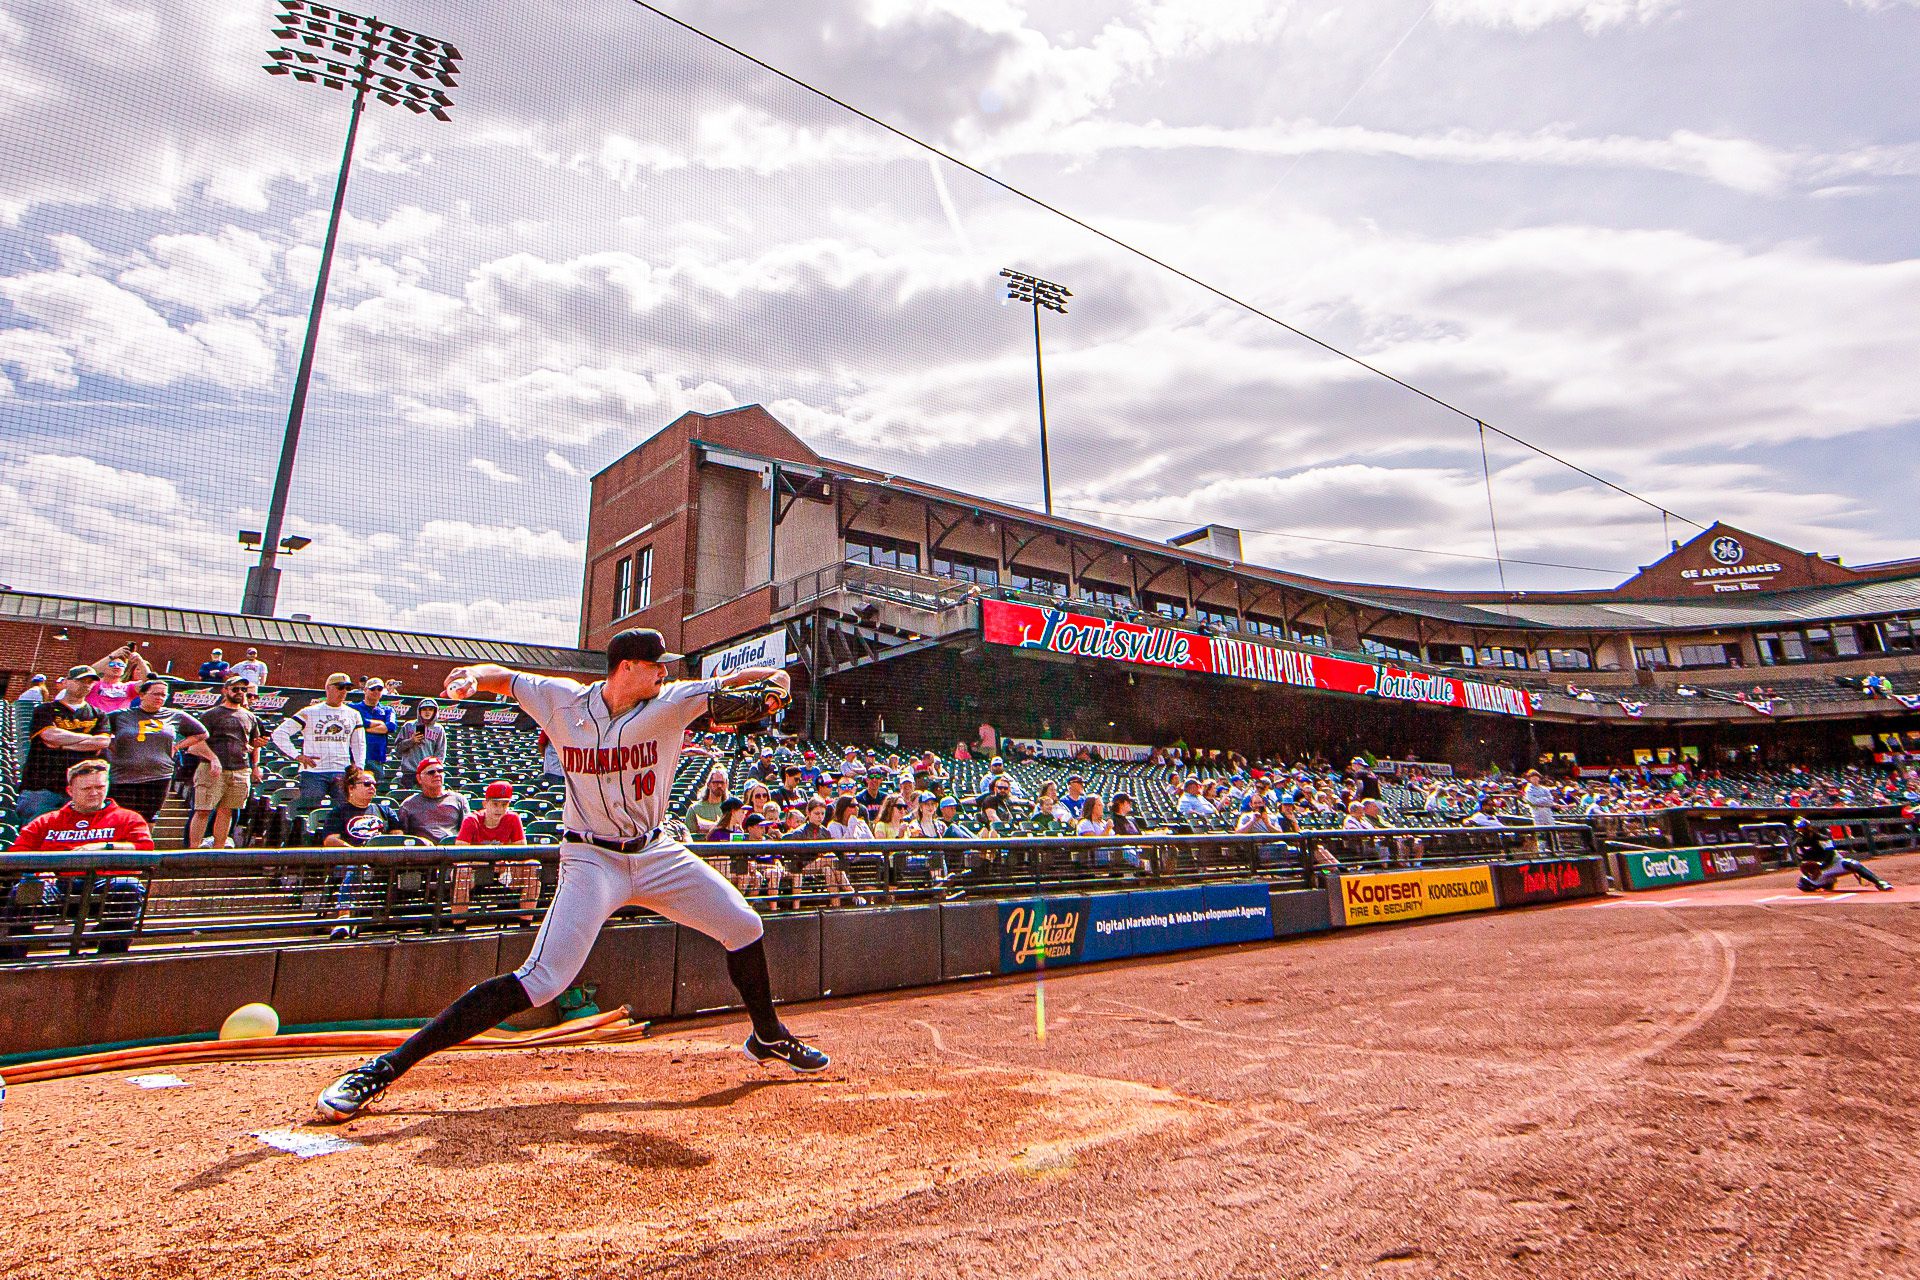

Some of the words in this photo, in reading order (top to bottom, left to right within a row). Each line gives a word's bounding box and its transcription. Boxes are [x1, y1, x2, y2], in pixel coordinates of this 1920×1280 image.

[1681, 570, 1699, 578] GE
[1702, 563, 1781, 576] APPLIANCES
[1713, 584, 1739, 592] Press
[1740, 582, 1760, 590] Box
[721, 640, 766, 671] Unified
[1020, 608, 1190, 665] Louisville
[1209, 638, 1316, 687] INDIANAPOLIS
[1360, 665, 1454, 702] Louisville
[1463, 681, 1528, 716] INDIANAPOLIS
[137, 719, 163, 742] P
[562, 740, 658, 775] INDIANAPOLIS
[632, 769, 656, 801] 10
[45, 828, 115, 841] CINCINNATI
[1642, 855, 1671, 877] Great
[1668, 854, 1690, 879] Clips
[1346, 879, 1422, 904] Koorsen
[1427, 880, 1489, 900] KOORSEN.COM
[1096, 919, 1125, 934] Digital
[1126, 915, 1167, 929] Marketing
[1168, 913, 1175, 924] &
[1176, 912, 1191, 923] Web
[1192, 907, 1240, 920] Development
[1241, 906, 1266, 918] Agency
[1350, 906, 1369, 918] FIRE
[1374, 905, 1380, 915] &
[1384, 900, 1423, 915] SECURITY
[1006, 907, 1079, 964] Hatfield
[1045, 945, 1071, 957] MEDIA
